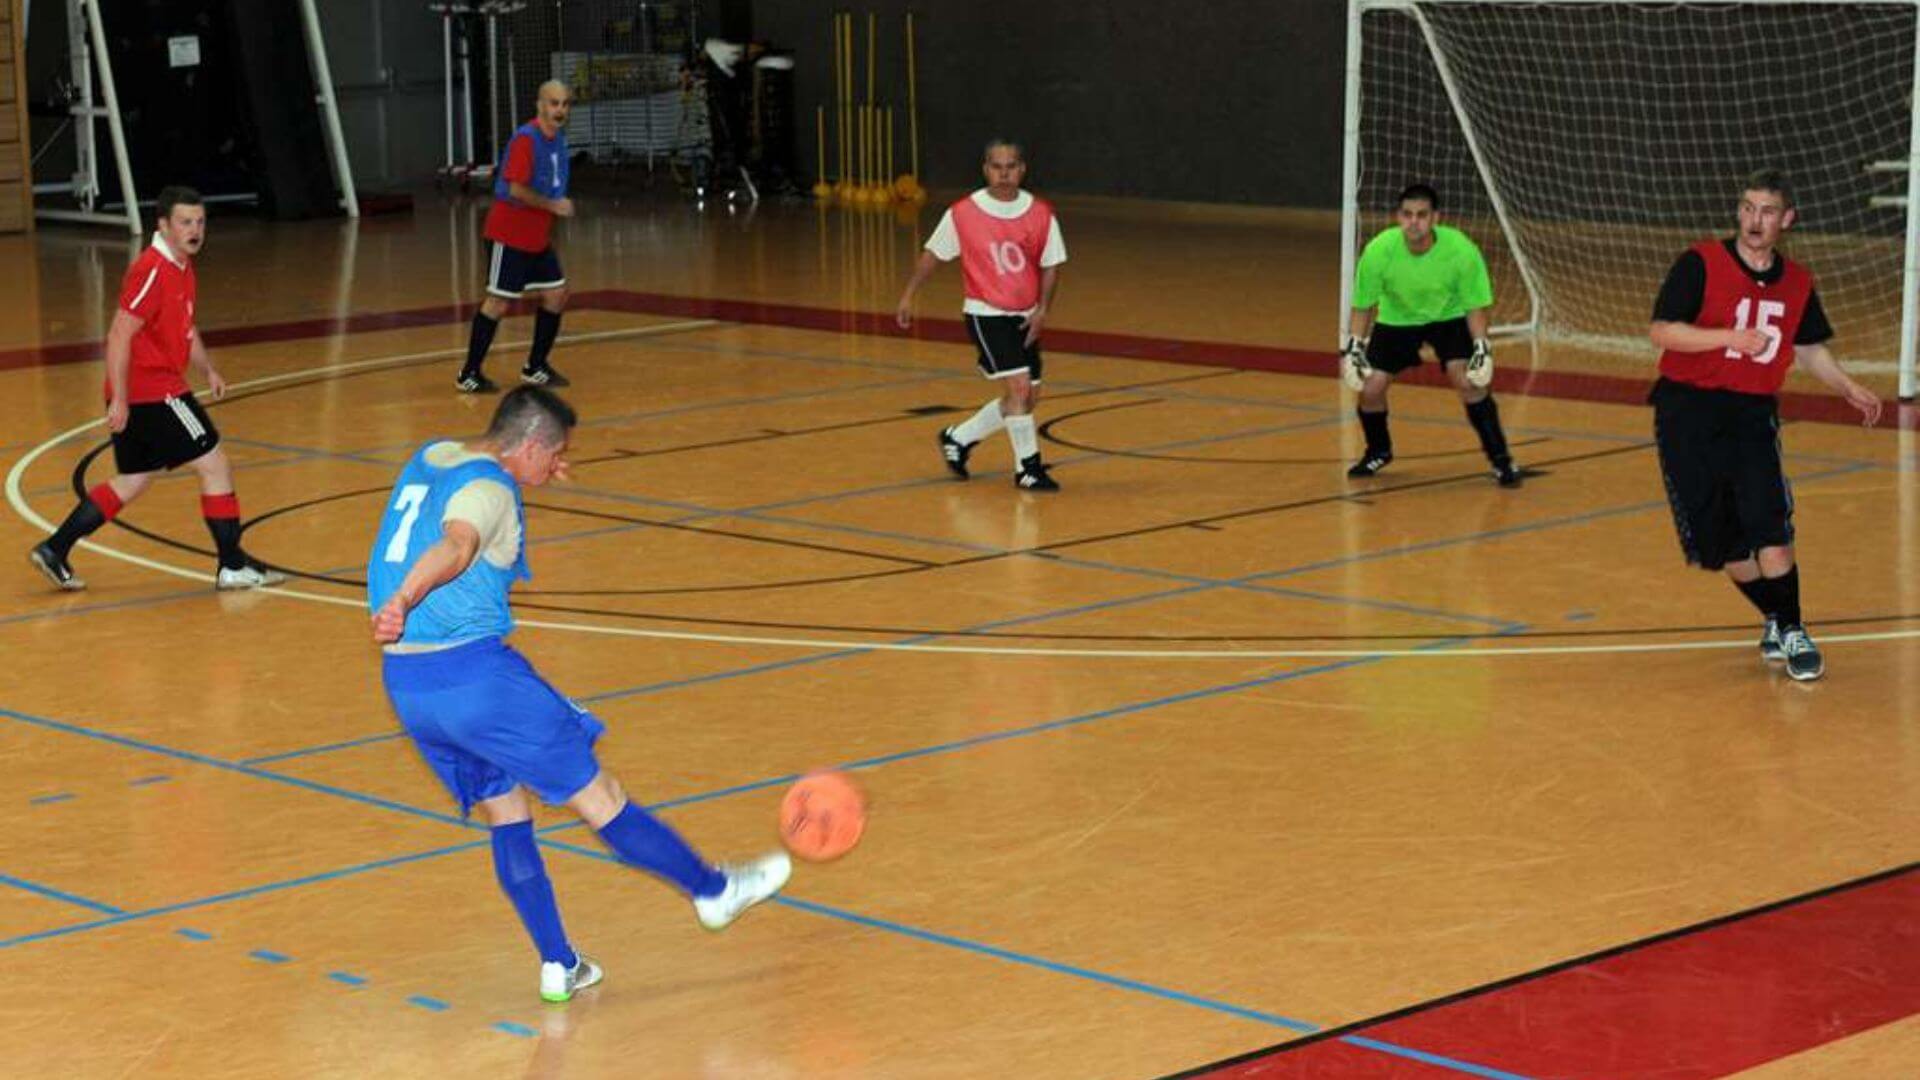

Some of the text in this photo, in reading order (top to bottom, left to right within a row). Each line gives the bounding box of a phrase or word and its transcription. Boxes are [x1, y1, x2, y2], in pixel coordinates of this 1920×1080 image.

[550, 152, 561, 188] 1
[989, 241, 1026, 275] 10
[1725, 298, 1785, 364] 15
[384, 484, 430, 562] 7
